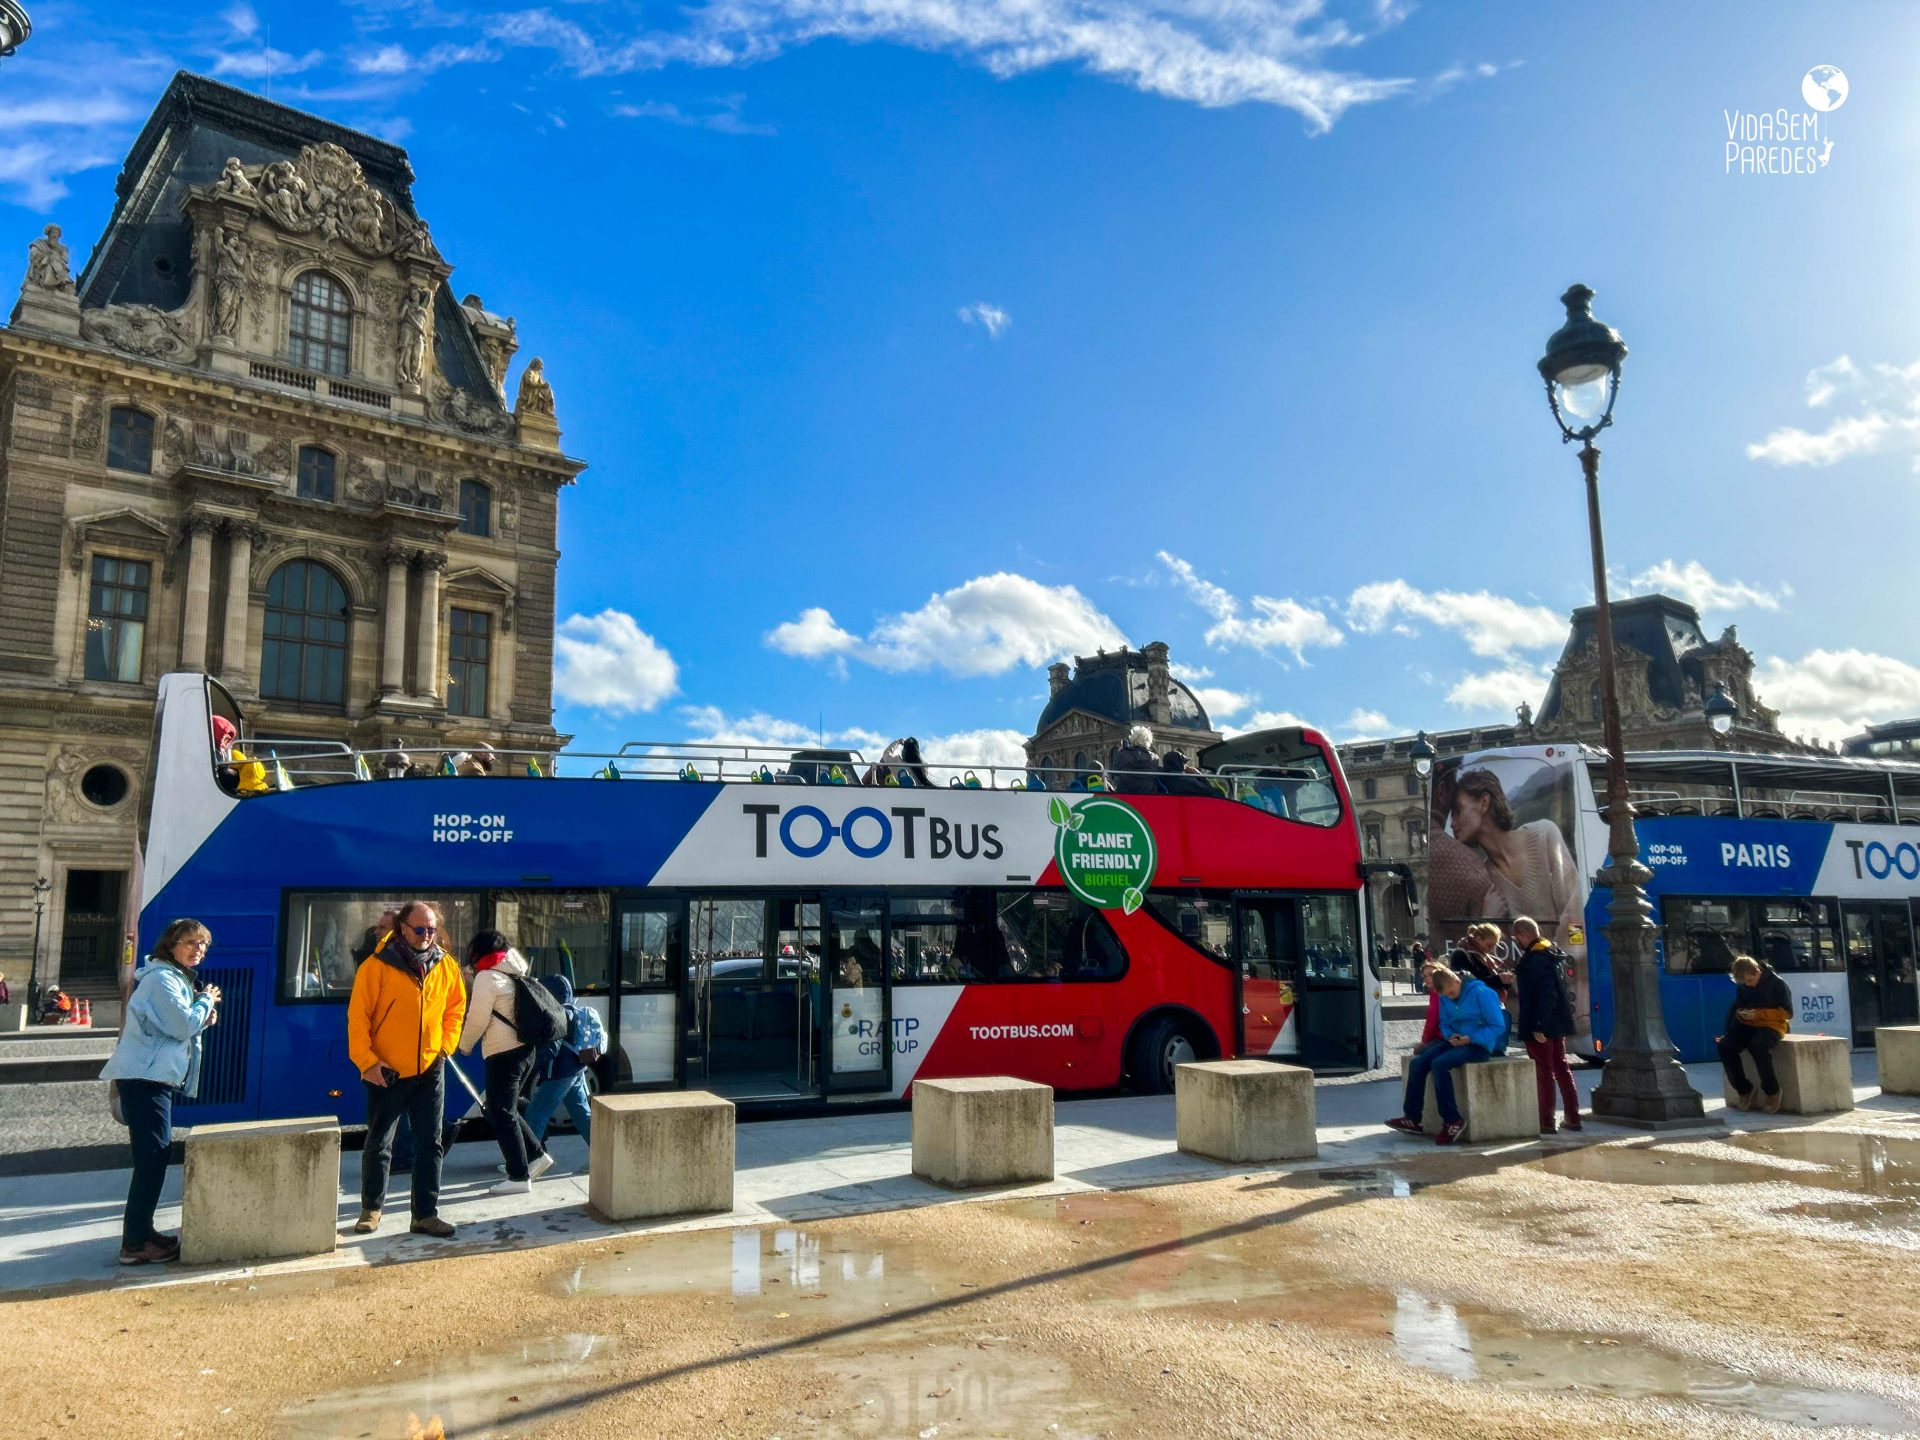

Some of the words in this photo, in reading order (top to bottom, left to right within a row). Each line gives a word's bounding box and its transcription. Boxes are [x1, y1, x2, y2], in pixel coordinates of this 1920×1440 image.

[433, 814, 505, 828] HOP-ON
[432, 830, 514, 843] HOP-OFF
[1078, 832, 1133, 849] PLANET
[1071, 853, 1142, 870] FRIENDLY
[1648, 855, 1688, 865] HOP-OFF
[1721, 843, 1791, 869] PARIS
[1845, 840, 1920, 880] TOO
[1084, 873, 1132, 887] BIOFUEL
[1801, 995, 1835, 1010] RATP
[1802, 1011, 1835, 1023] GROUP
[969, 1024, 1074, 1040] TOOTBUS.COM
